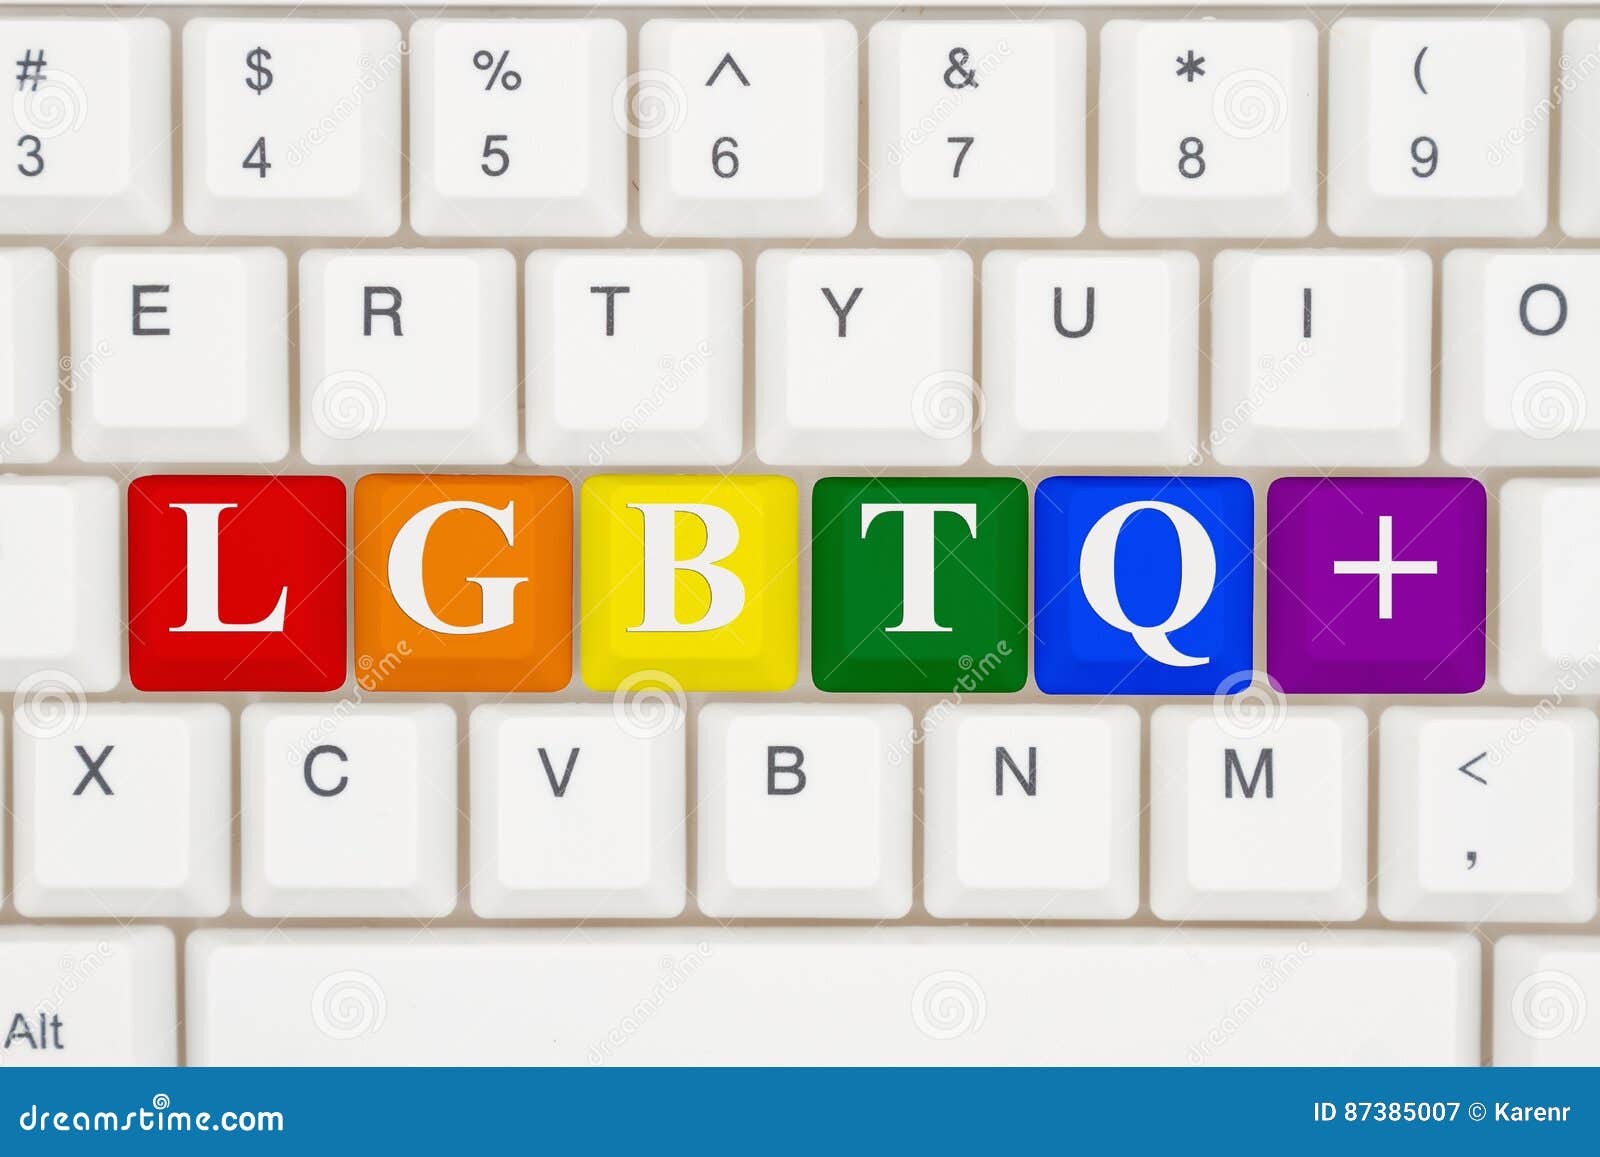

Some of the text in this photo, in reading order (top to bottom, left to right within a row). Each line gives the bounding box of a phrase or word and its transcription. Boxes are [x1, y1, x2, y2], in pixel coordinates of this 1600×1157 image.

[245, 46, 274, 96] $
[472, 50, 522, 91] %
[943, 46, 980, 89] &
[1413, 46, 1428, 95] (
[16, 134, 45, 177] 3
[241, 136, 272, 178] 4
[480, 134, 510, 177] 5
[711, 136, 740, 179] 6
[946, 136, 975, 179] 7
[1178, 136, 1206, 179] 8
[1411, 136, 1439, 178] 9
[131, 284, 171, 337] E
[363, 286, 404, 337] R
[590, 286, 631, 337] T
[821, 287, 863, 338] Y
[1052, 286, 1096, 339] U
[1518, 283, 1568, 337] O
[72, 745, 115, 796] X
[303, 744, 349, 798] C
[537, 747, 580, 798] V
[767, 745, 807, 796] B
[995, 746, 1037, 796] N
[1224, 748, 1274, 799] M
[1457, 750, 1489, 786] <
[4, 1013, 65, 1050] Alt
